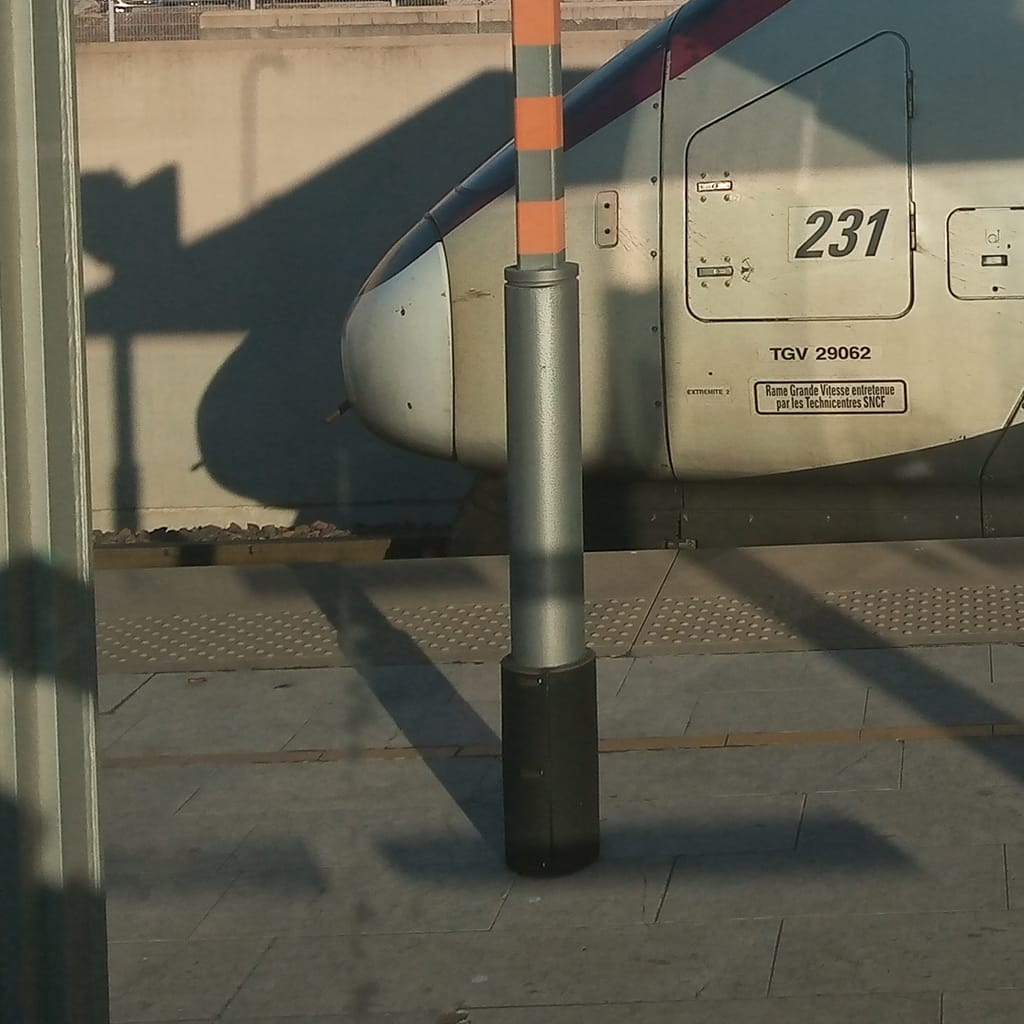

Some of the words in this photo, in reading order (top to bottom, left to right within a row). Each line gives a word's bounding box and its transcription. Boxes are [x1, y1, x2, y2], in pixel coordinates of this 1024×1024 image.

[795, 208, 890, 259] 231
[769, 347, 808, 360] TGV
[815, 346, 872, 360] 29062
[765, 384, 788, 397] Rame
[789, 383, 819, 396] Grande
[820, 383, 850, 396] Vitesse
[851, 383, 895, 396] entretenue
[776, 397, 790, 411] par
[791, 397, 804, 409] les
[804, 396, 862, 409] Technicentres
[863, 395, 886, 408] SNCF
